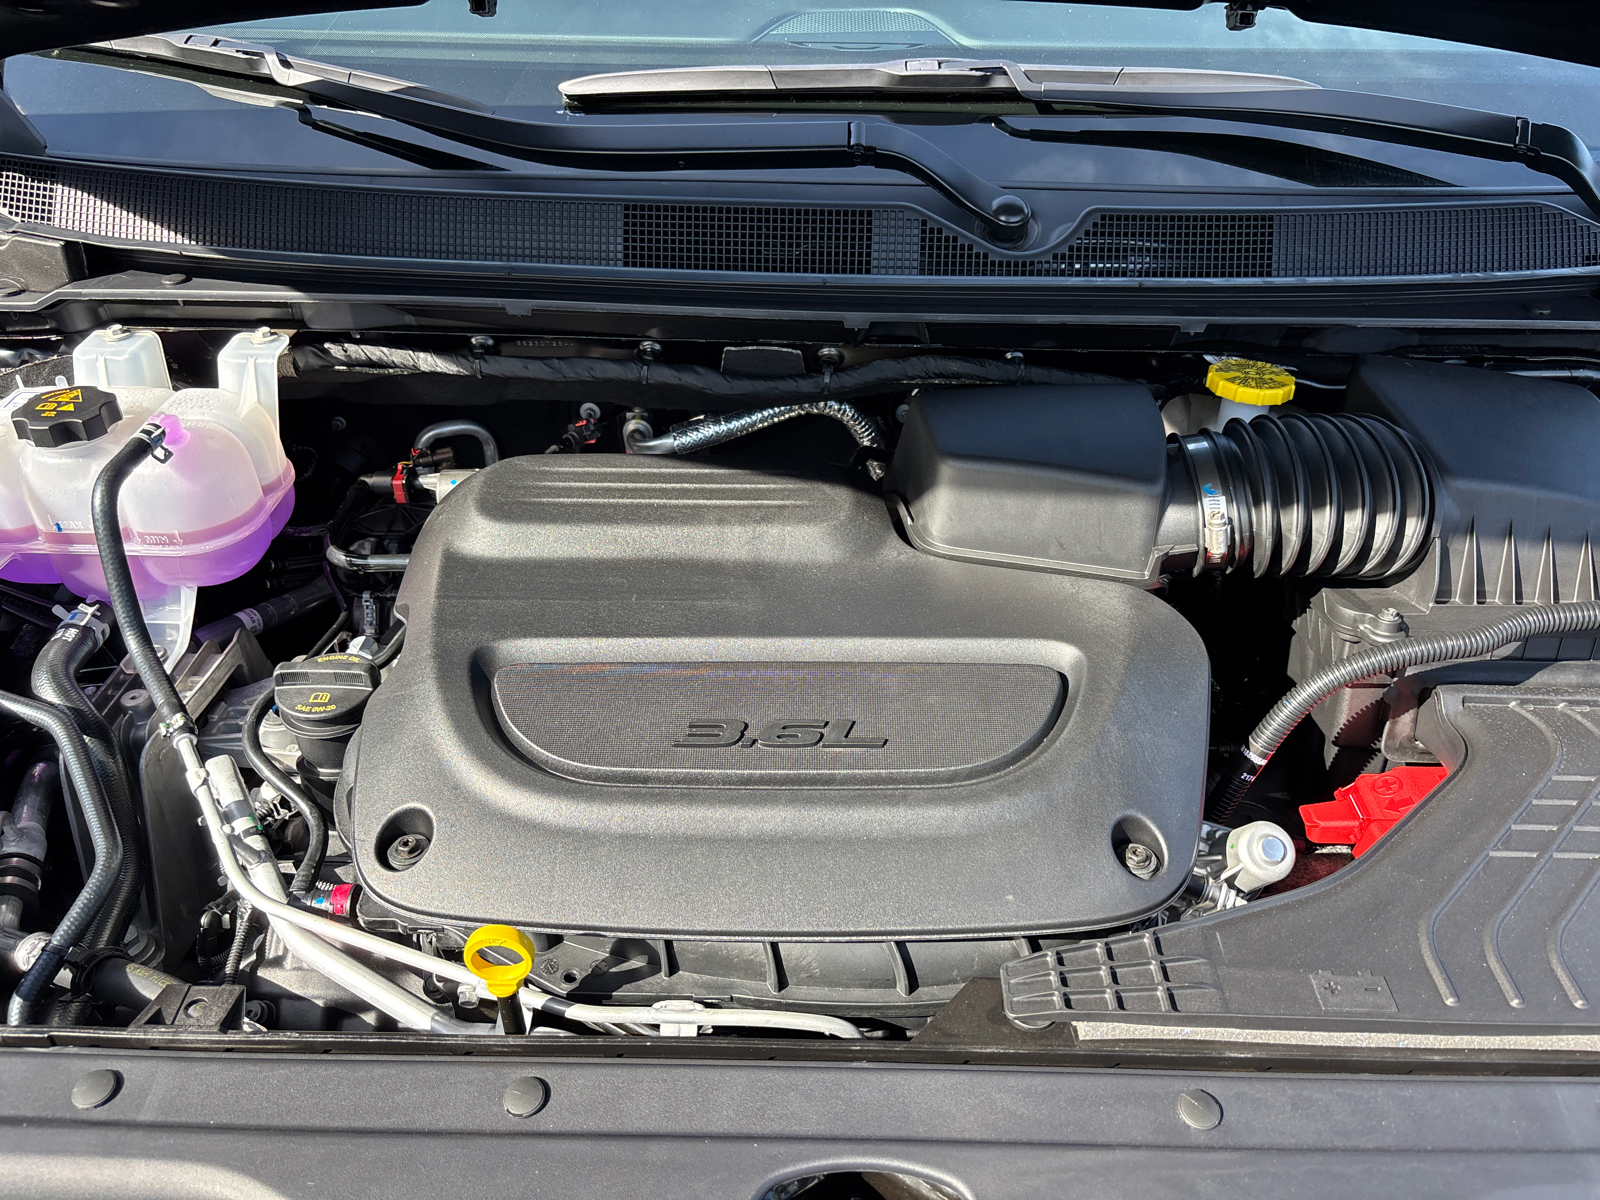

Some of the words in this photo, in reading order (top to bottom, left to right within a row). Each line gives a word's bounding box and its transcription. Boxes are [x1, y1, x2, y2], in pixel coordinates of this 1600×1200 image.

[59, 521, 84, 530] MAX
[144, 535, 170, 544] MIN
[62, 627, 80, 642] HOT
[317, 655, 349, 663] ENGINE
[349, 655, 360, 663] OIL
[295, 704, 312, 712] SAE
[311, 704, 337, 713] 0W-20
[673, 718, 889, 748] 3.6L
